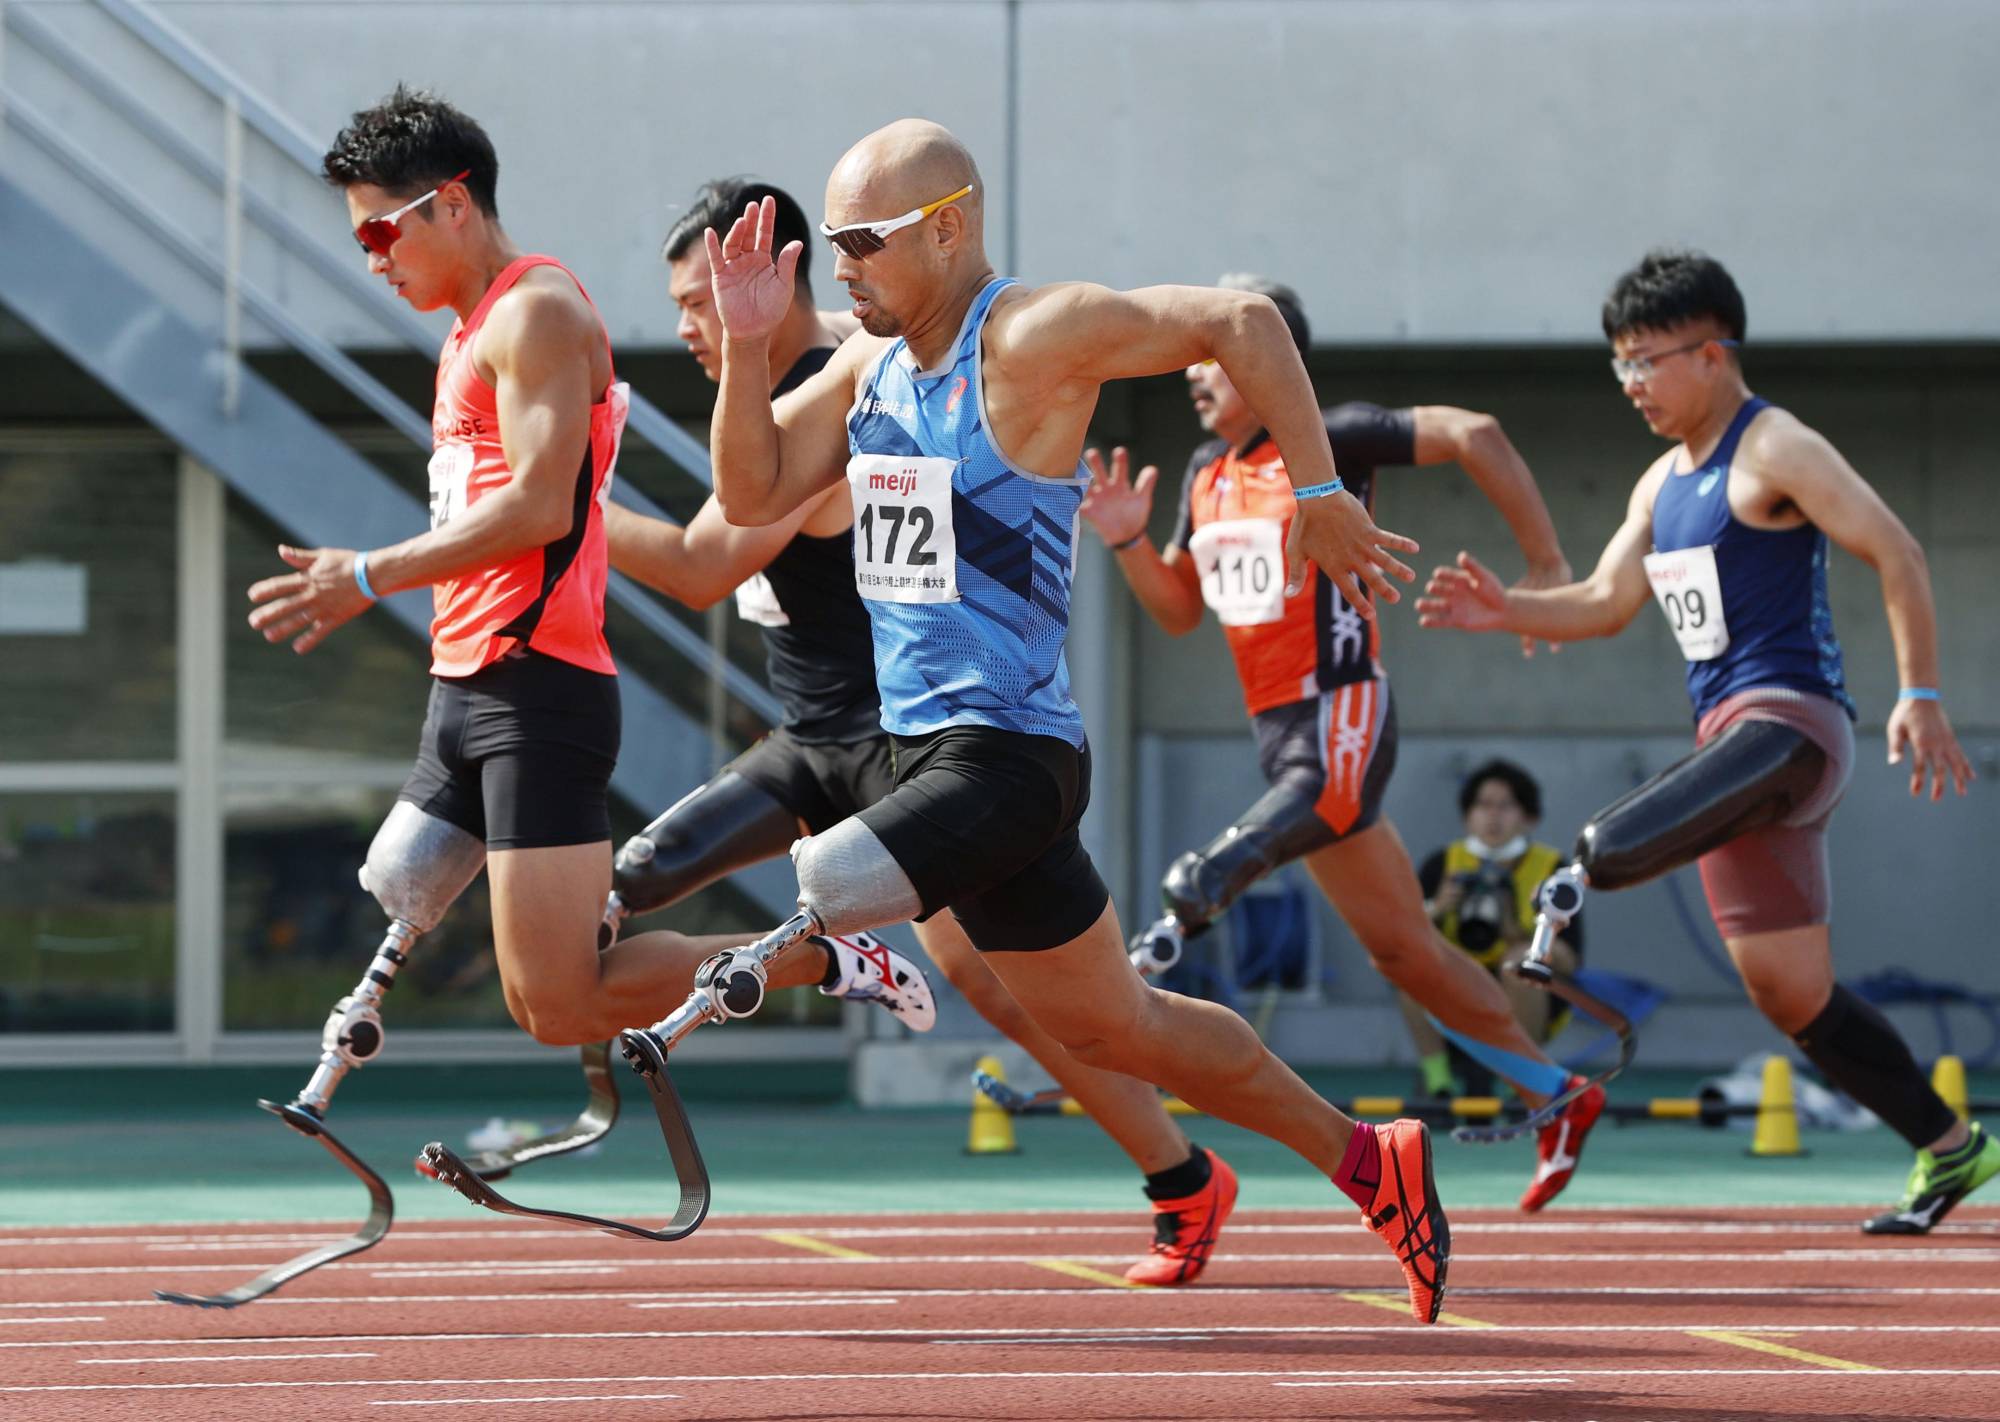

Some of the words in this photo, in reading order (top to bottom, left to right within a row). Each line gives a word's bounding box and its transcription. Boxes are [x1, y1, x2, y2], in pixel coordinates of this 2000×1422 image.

[869, 468, 918, 496] meiji
[860, 503, 938, 566] 172
[1211, 556, 1271, 596] 110
